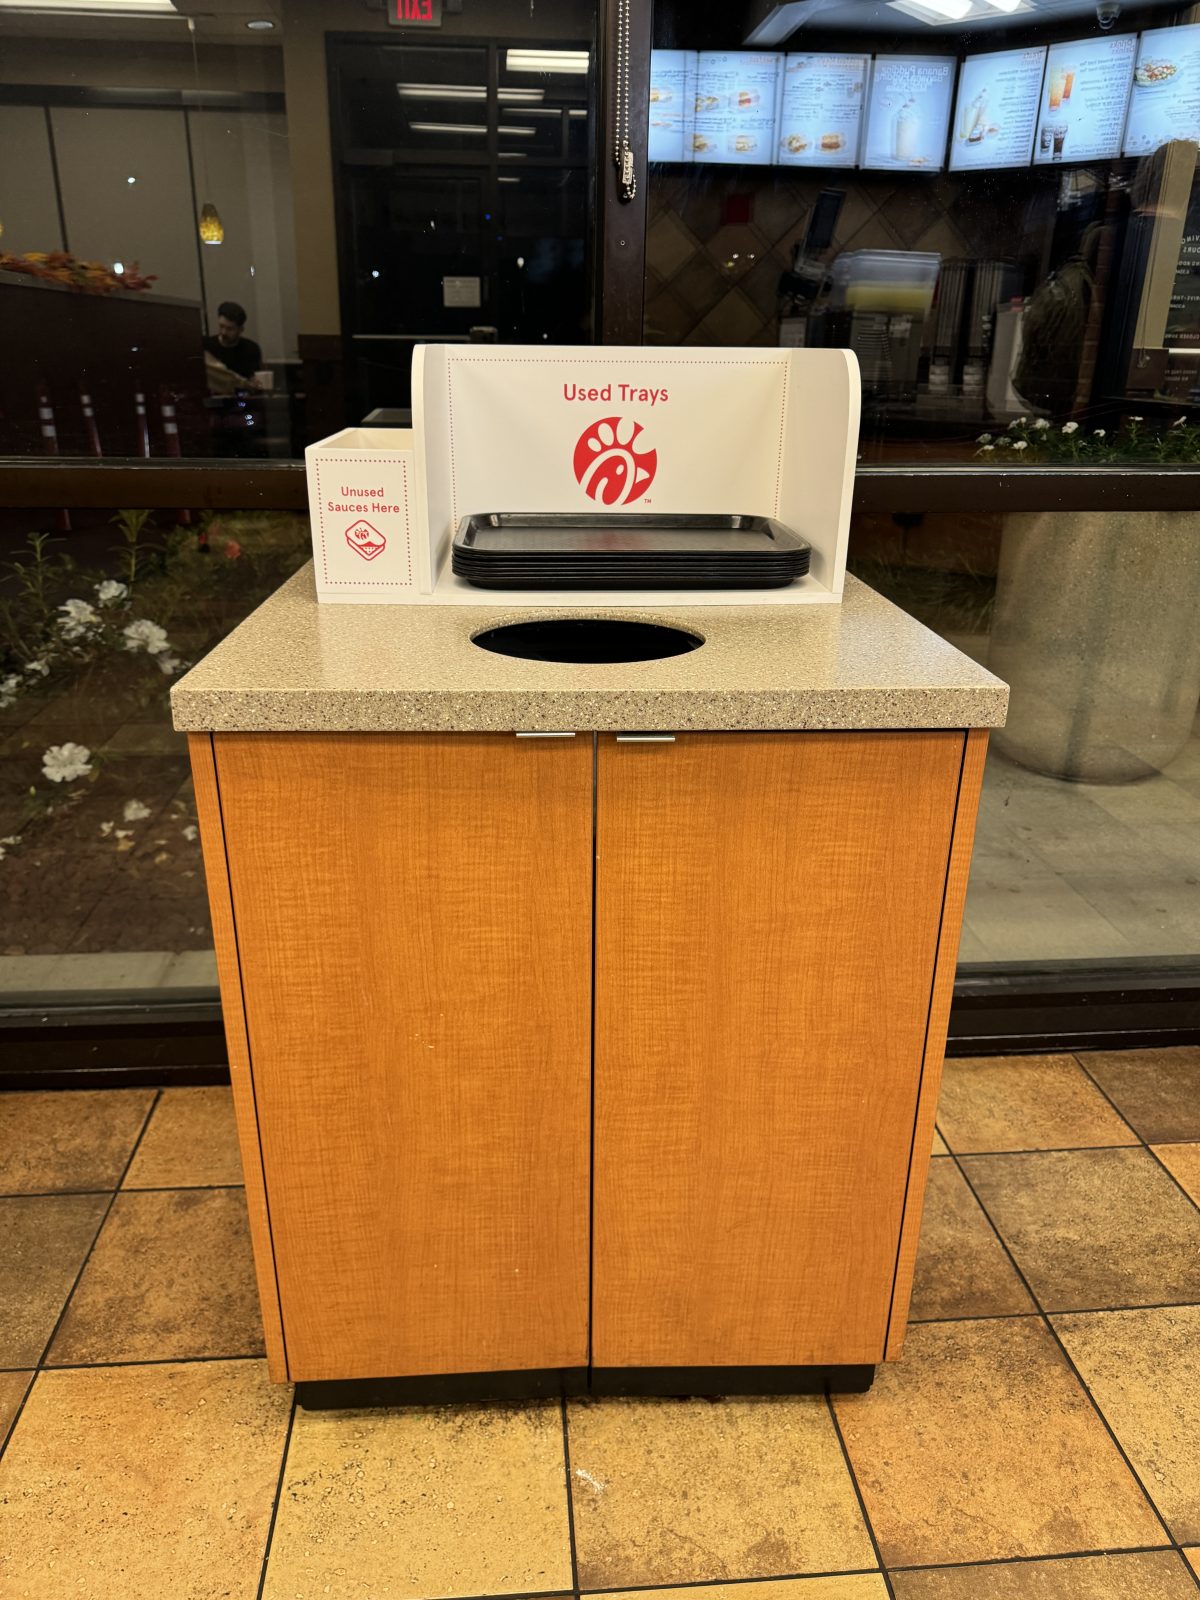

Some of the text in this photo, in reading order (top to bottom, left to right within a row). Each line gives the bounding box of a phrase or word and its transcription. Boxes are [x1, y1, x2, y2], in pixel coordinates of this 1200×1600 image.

[563, 383, 669, 407] Used Trays
[340, 486, 385, 498] Unused
[327, 501, 400, 513] Sauces Here
